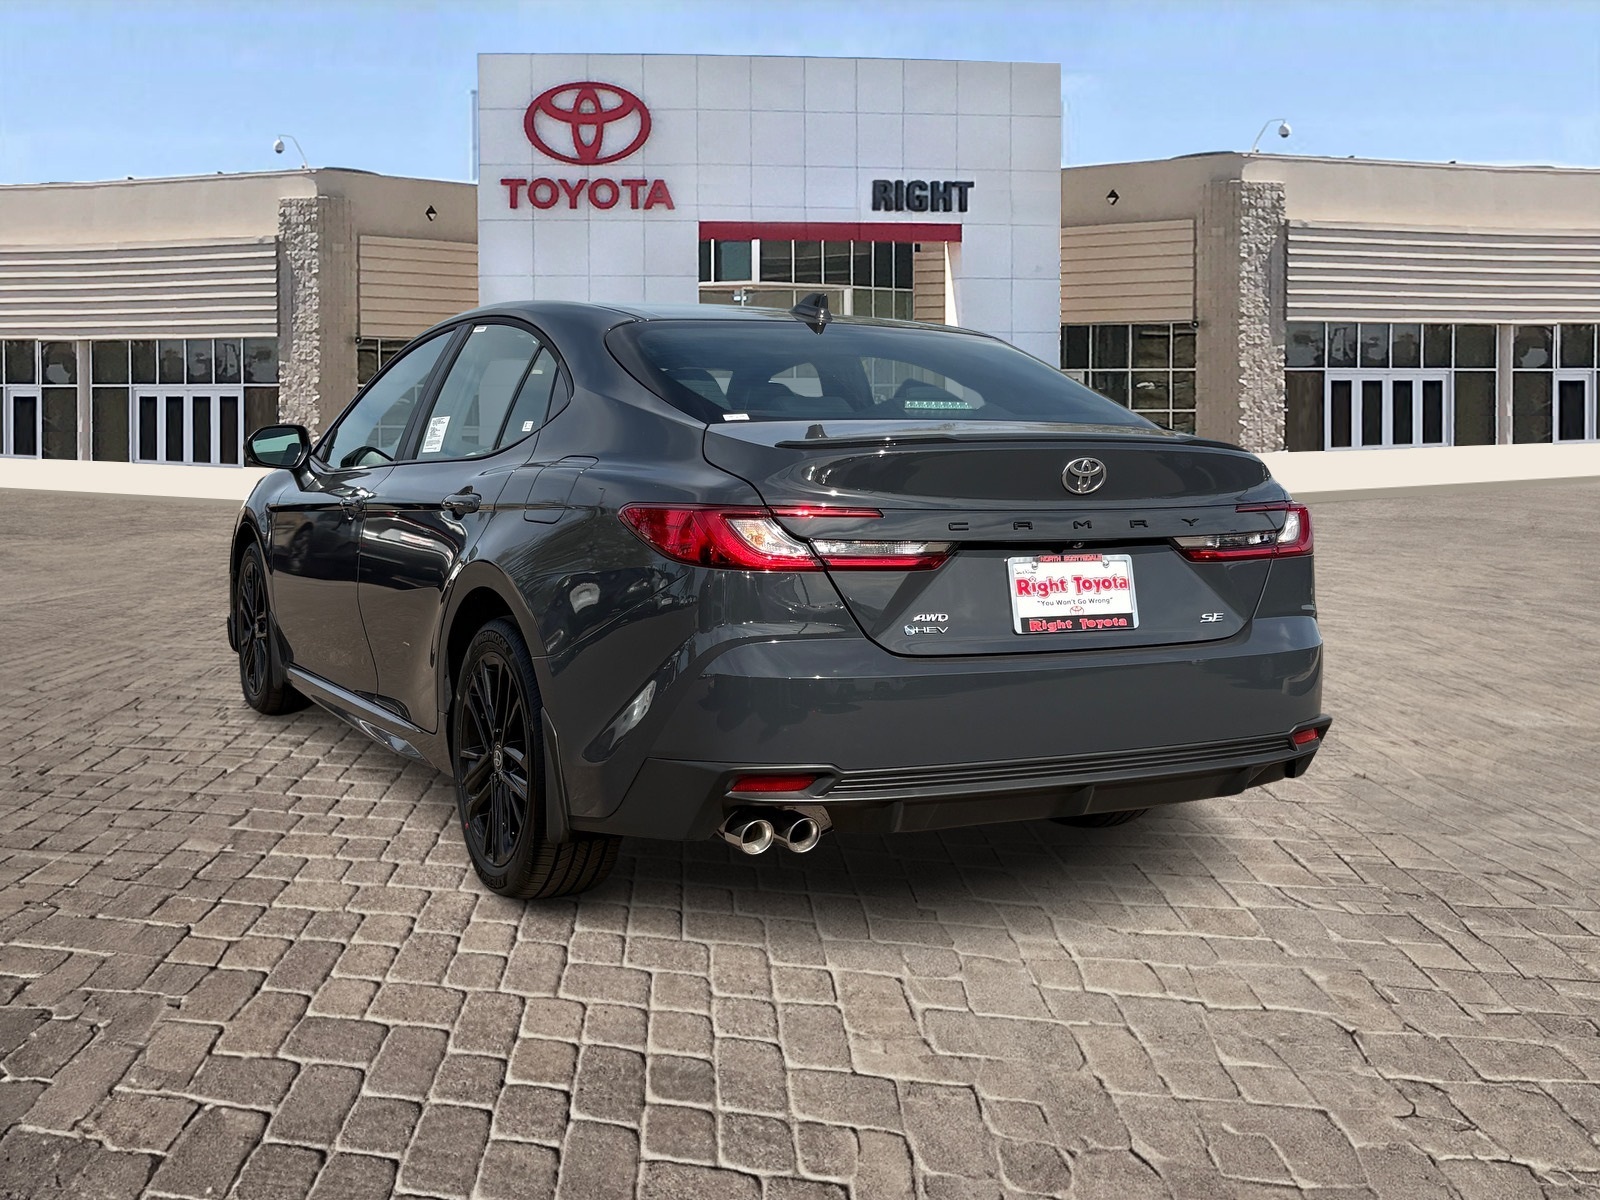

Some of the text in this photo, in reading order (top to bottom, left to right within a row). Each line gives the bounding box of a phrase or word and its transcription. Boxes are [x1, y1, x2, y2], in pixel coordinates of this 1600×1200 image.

[501, 179, 675, 210] TOYOTA
[872, 180, 974, 213] RIGHT
[948, 518, 1199, 531] CAMRY
[1015, 576, 1129, 598] Right Toyota
[1089, 597, 1113, 605] Wrong"
[913, 613, 949, 621] AWD
[1200, 613, 1224, 622] SE
[1029, 617, 1127, 632] Right Toyota
